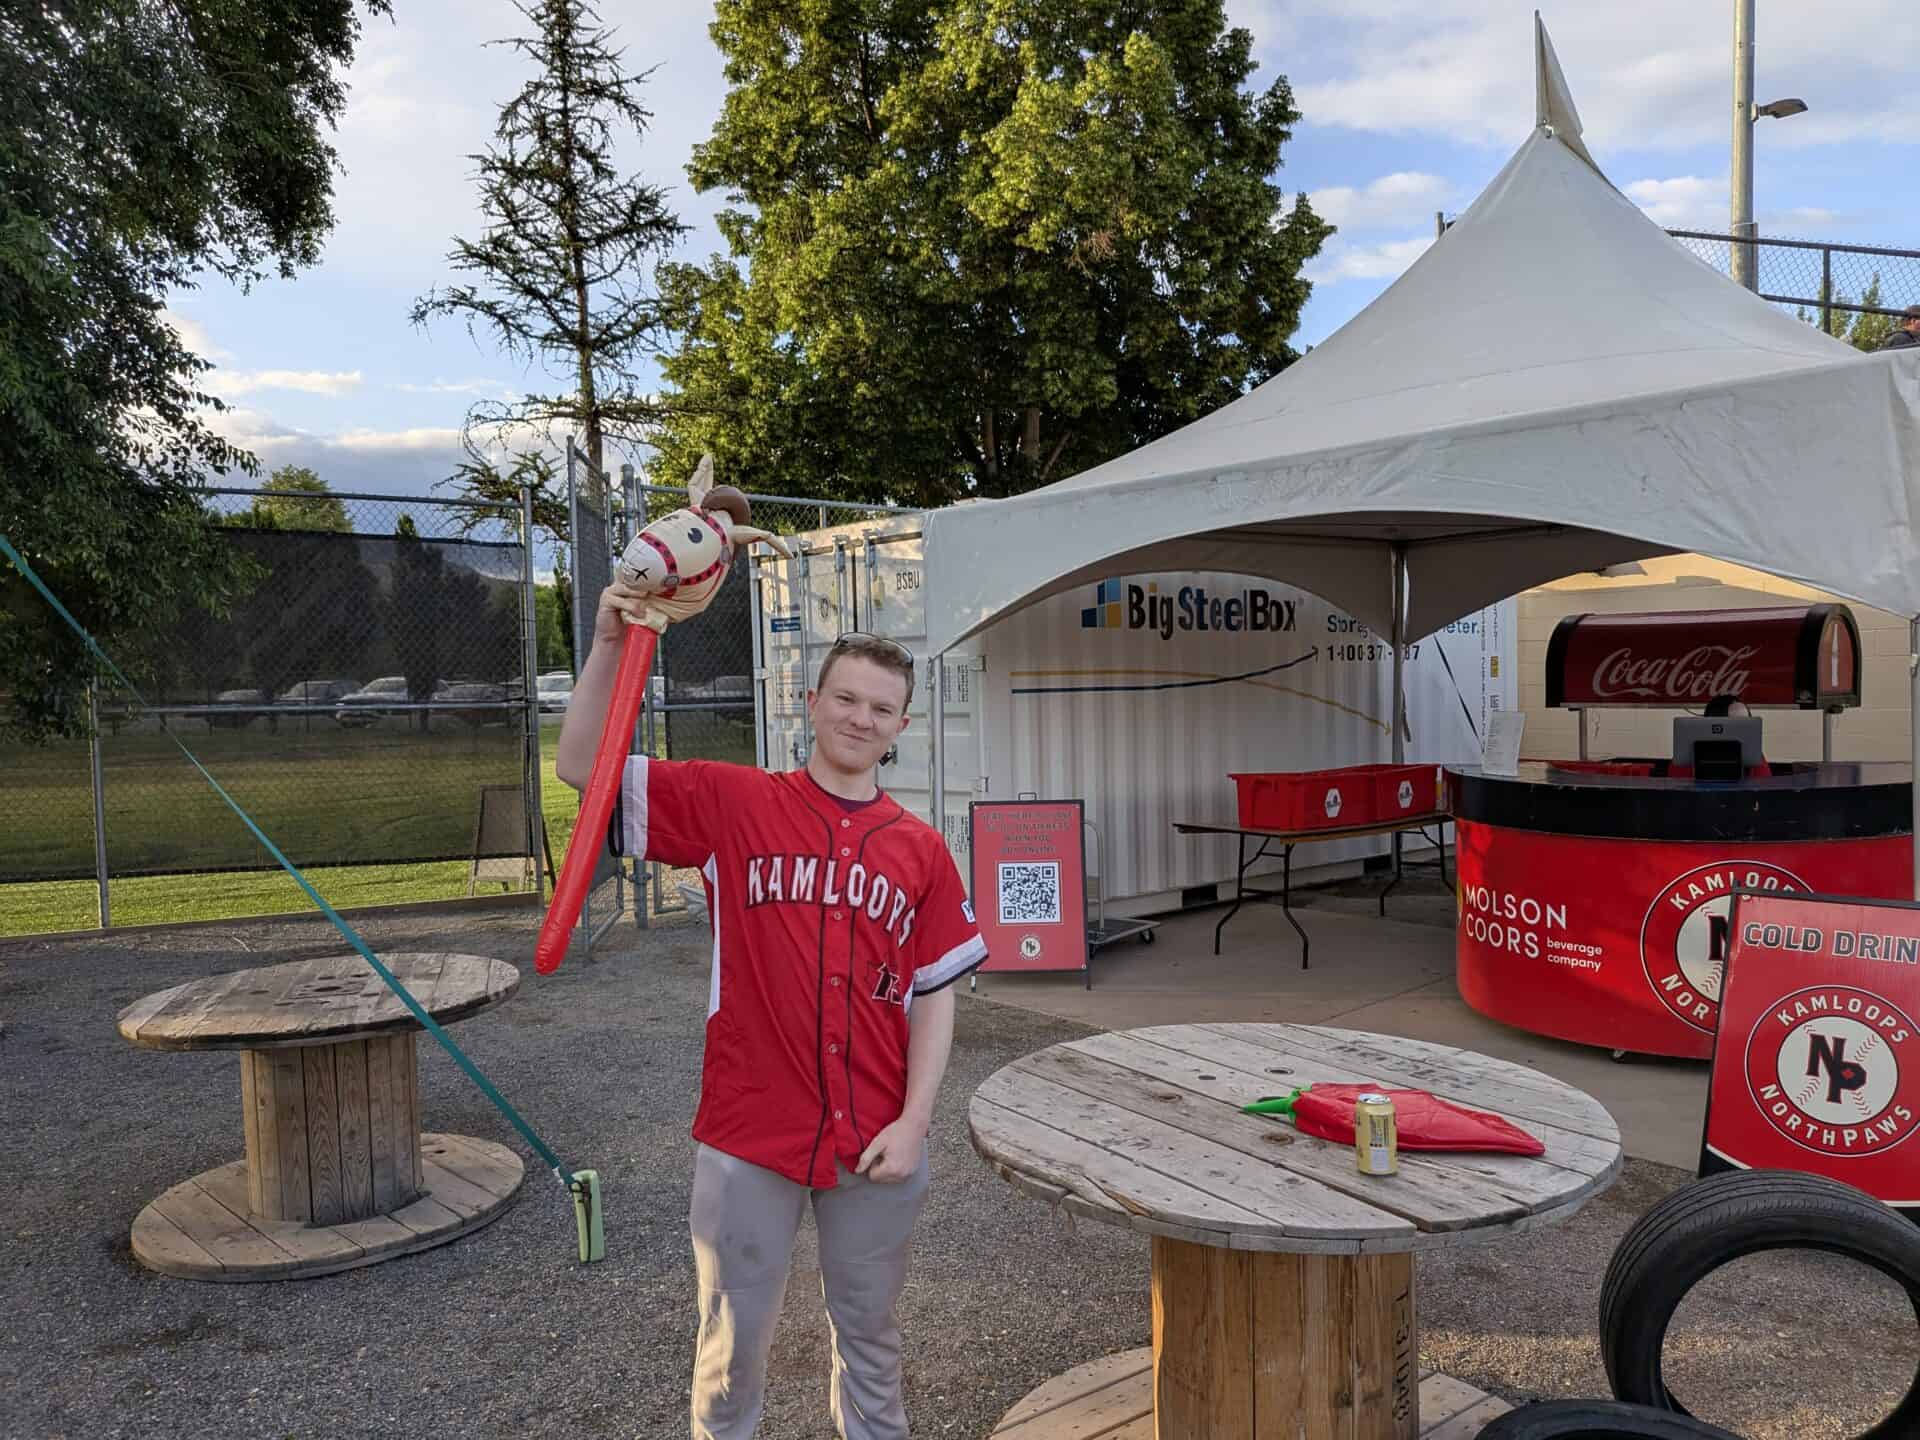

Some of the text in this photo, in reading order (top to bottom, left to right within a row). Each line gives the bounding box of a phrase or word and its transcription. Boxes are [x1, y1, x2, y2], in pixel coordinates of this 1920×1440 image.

[896, 568, 920, 591] BSBU
[747, 855, 916, 949] KAMLOOPS
[1466, 884, 1567, 929] MOLSON
[1466, 913, 1540, 958] COORS
[1547, 936, 1602, 956] beverage
[1744, 922, 1823, 953] COLD
[1547, 953, 1601, 972] company
[1777, 995, 1909, 1043] KAMLOOPS
[1760, 1083, 1911, 1146] NORTHPAWS
